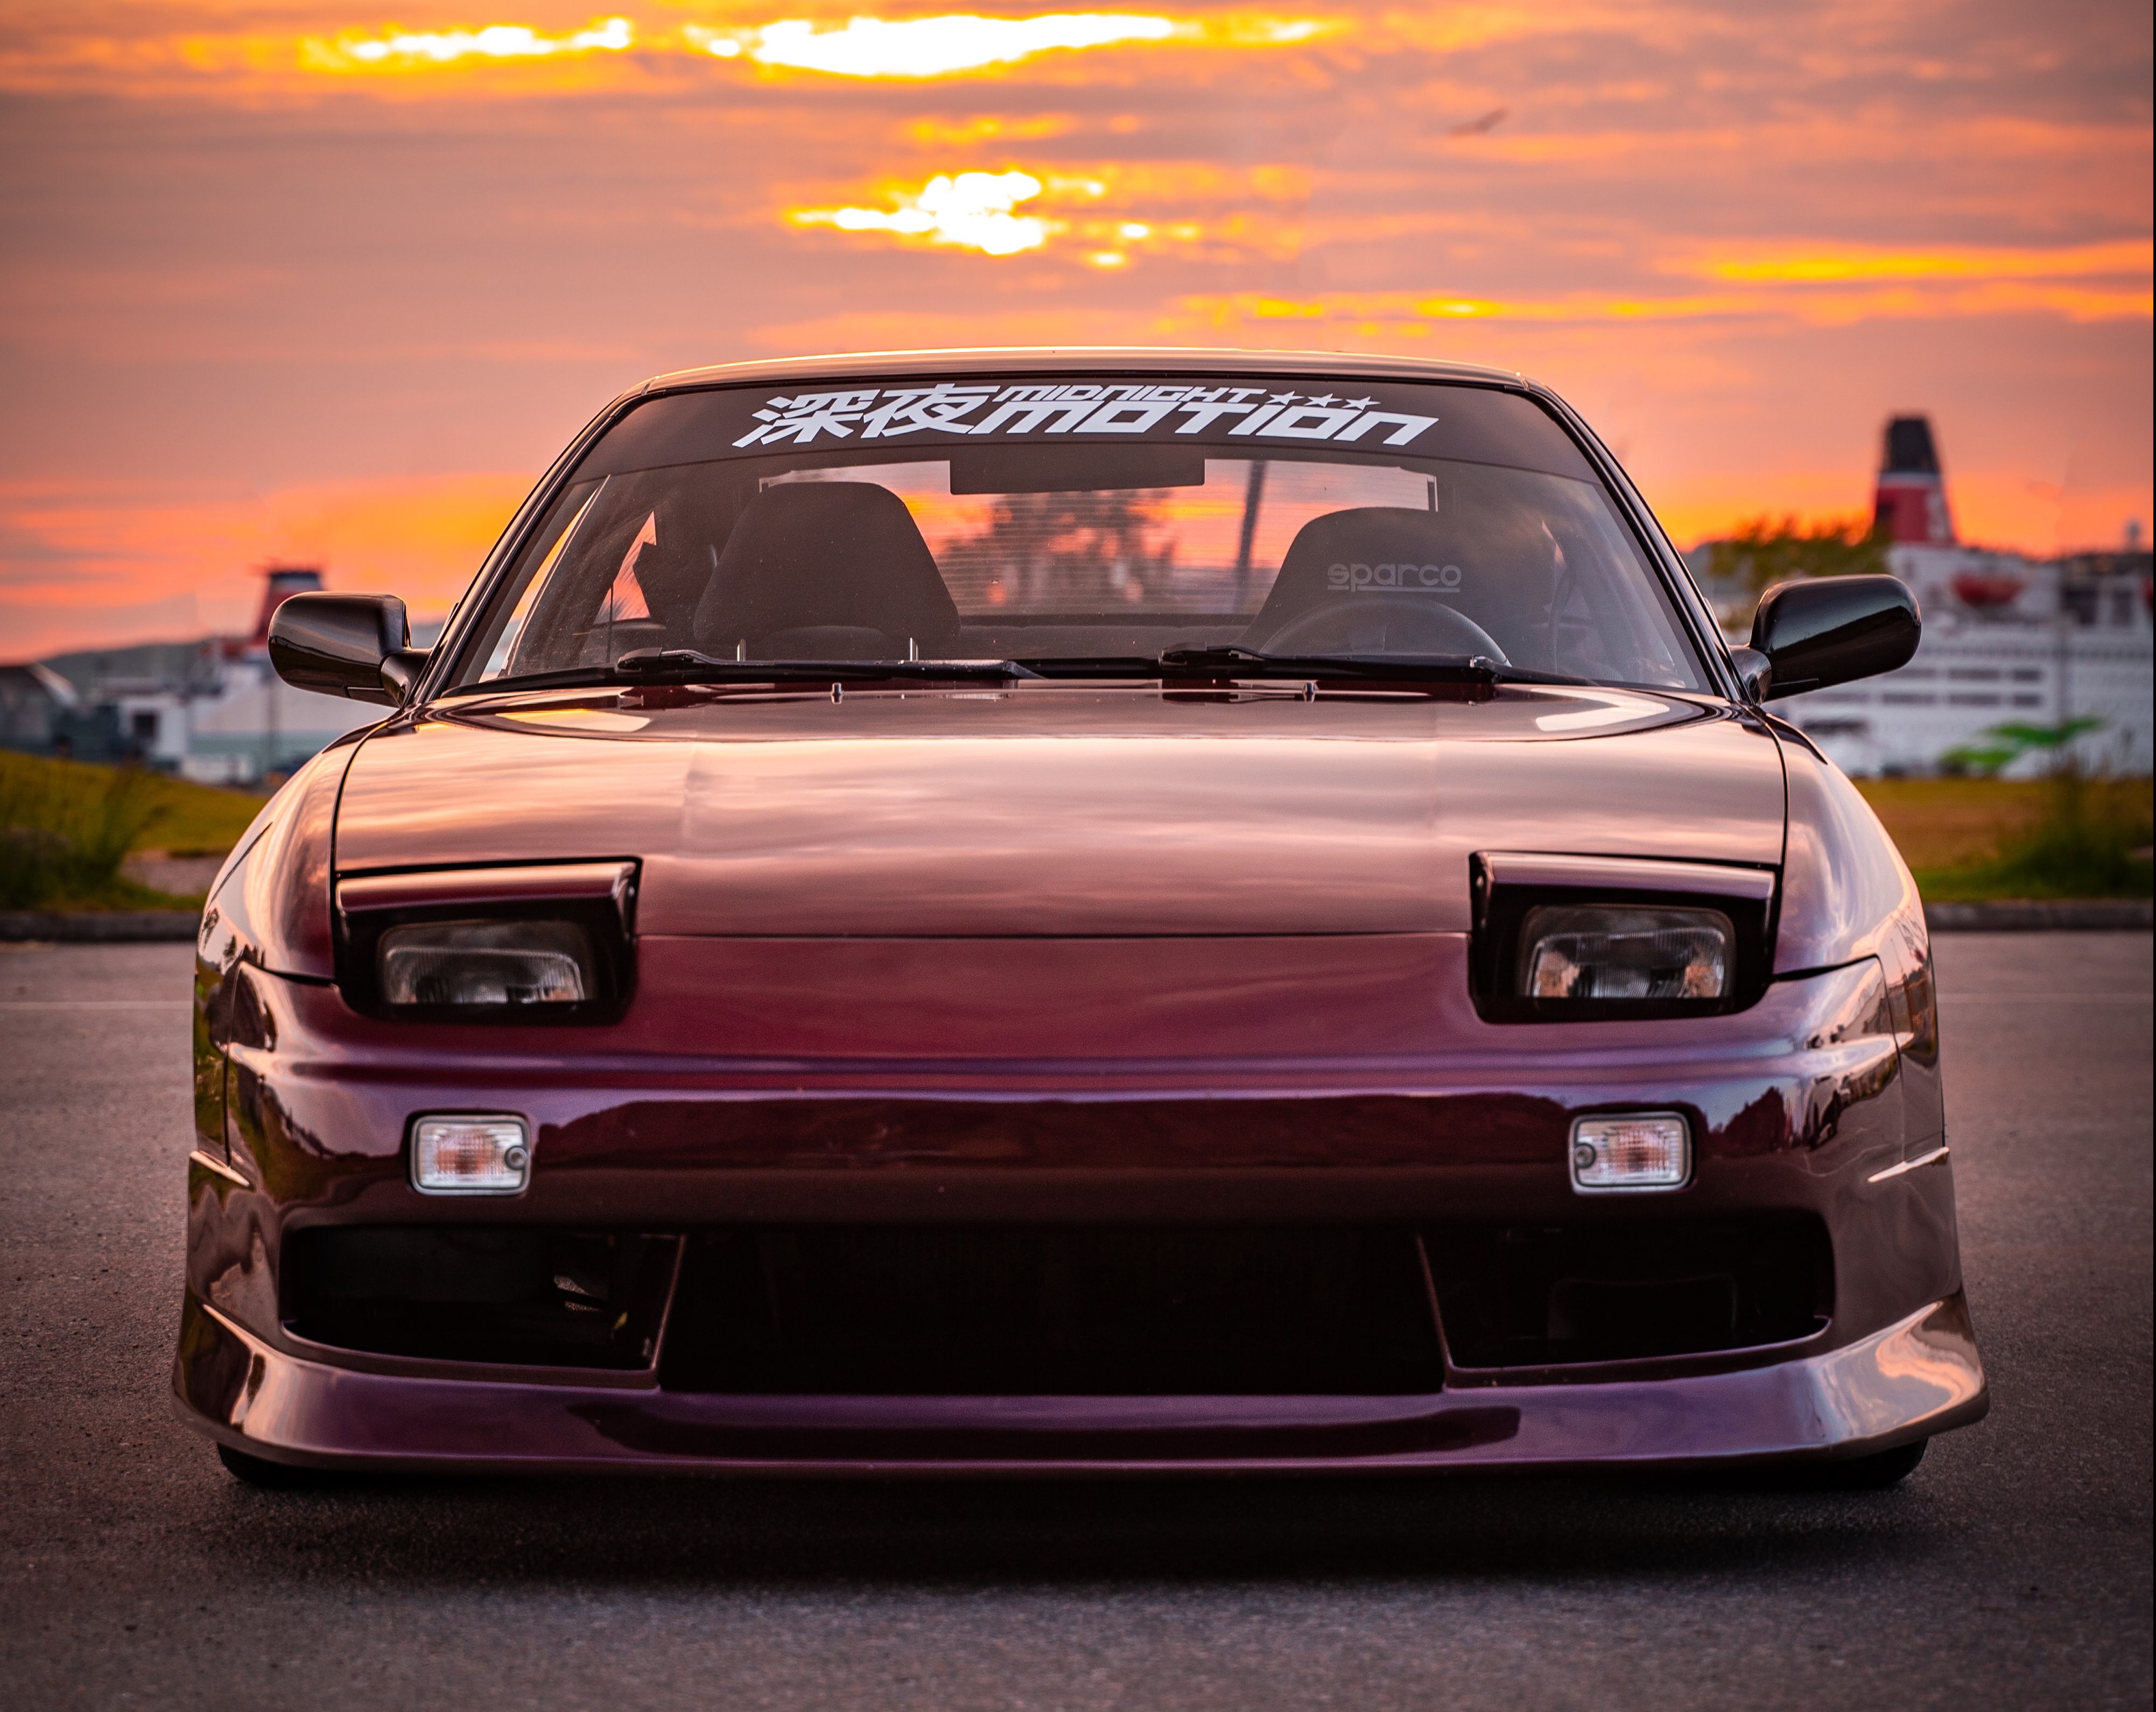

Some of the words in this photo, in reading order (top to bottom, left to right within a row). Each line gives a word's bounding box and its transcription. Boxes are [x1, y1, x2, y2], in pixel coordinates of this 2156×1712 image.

[992, 385, 1267, 403] MIDNIGHT
[732, 383, 1001, 448] 深夜
[1327, 563, 1462, 592] sparco
